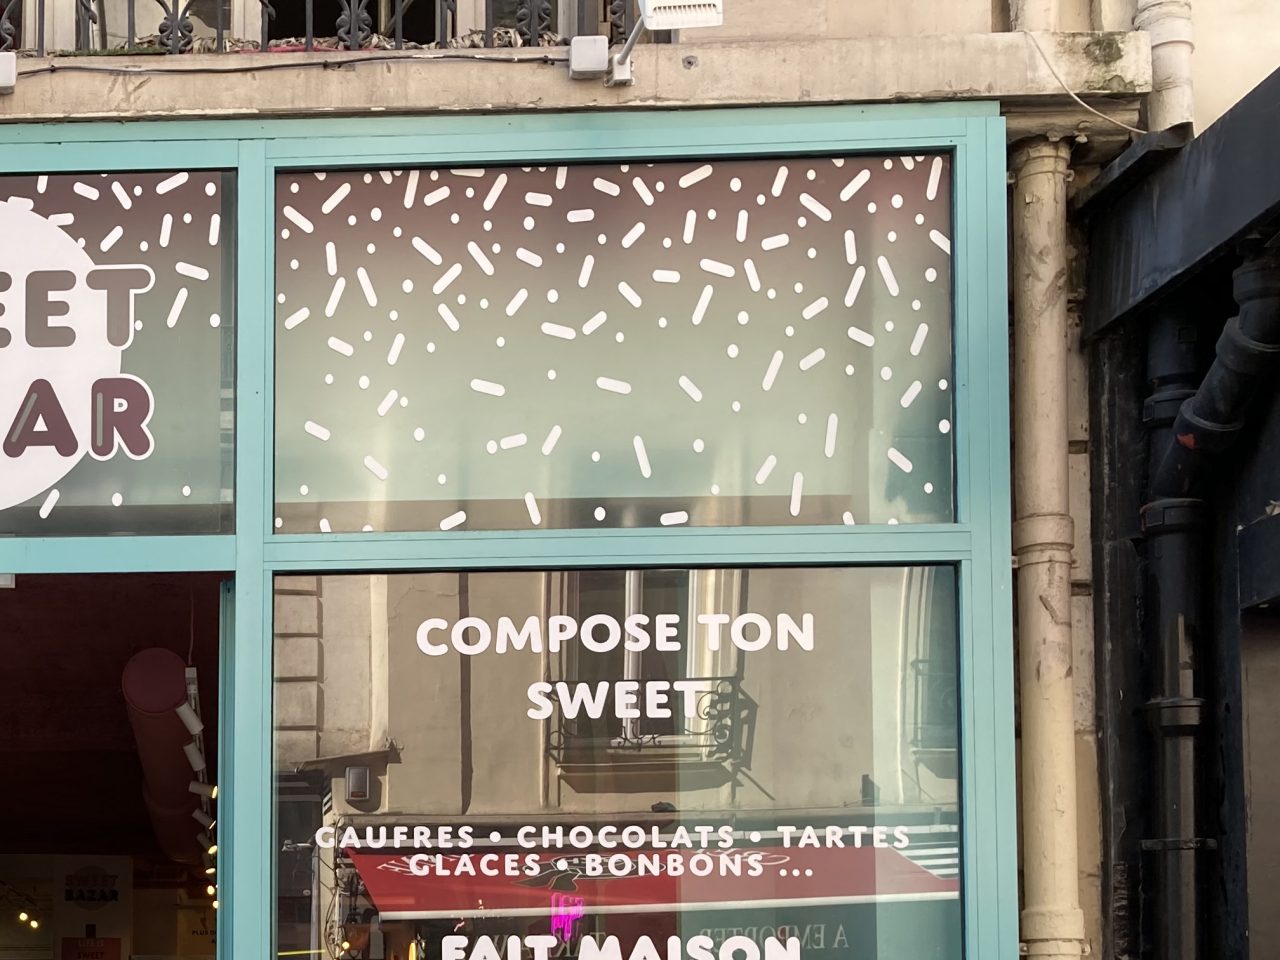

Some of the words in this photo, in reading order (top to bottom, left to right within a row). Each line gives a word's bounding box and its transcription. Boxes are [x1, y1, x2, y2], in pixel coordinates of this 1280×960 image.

[416, 612, 681, 656] COMPOSE
[697, 612, 815, 652] TON
[526, 681, 707, 721] SWEET
[315, 825, 475, 848] GAUFRES
[516, 825, 735, 848] CHOCOLATS
[776, 825, 911, 849] TARTES
[409, 853, 541, 877] GLACES
[584, 853, 764, 877] BONBONS
[65, 888, 119, 902] BAZAR
[77, 951, 105, 960] SWEET
